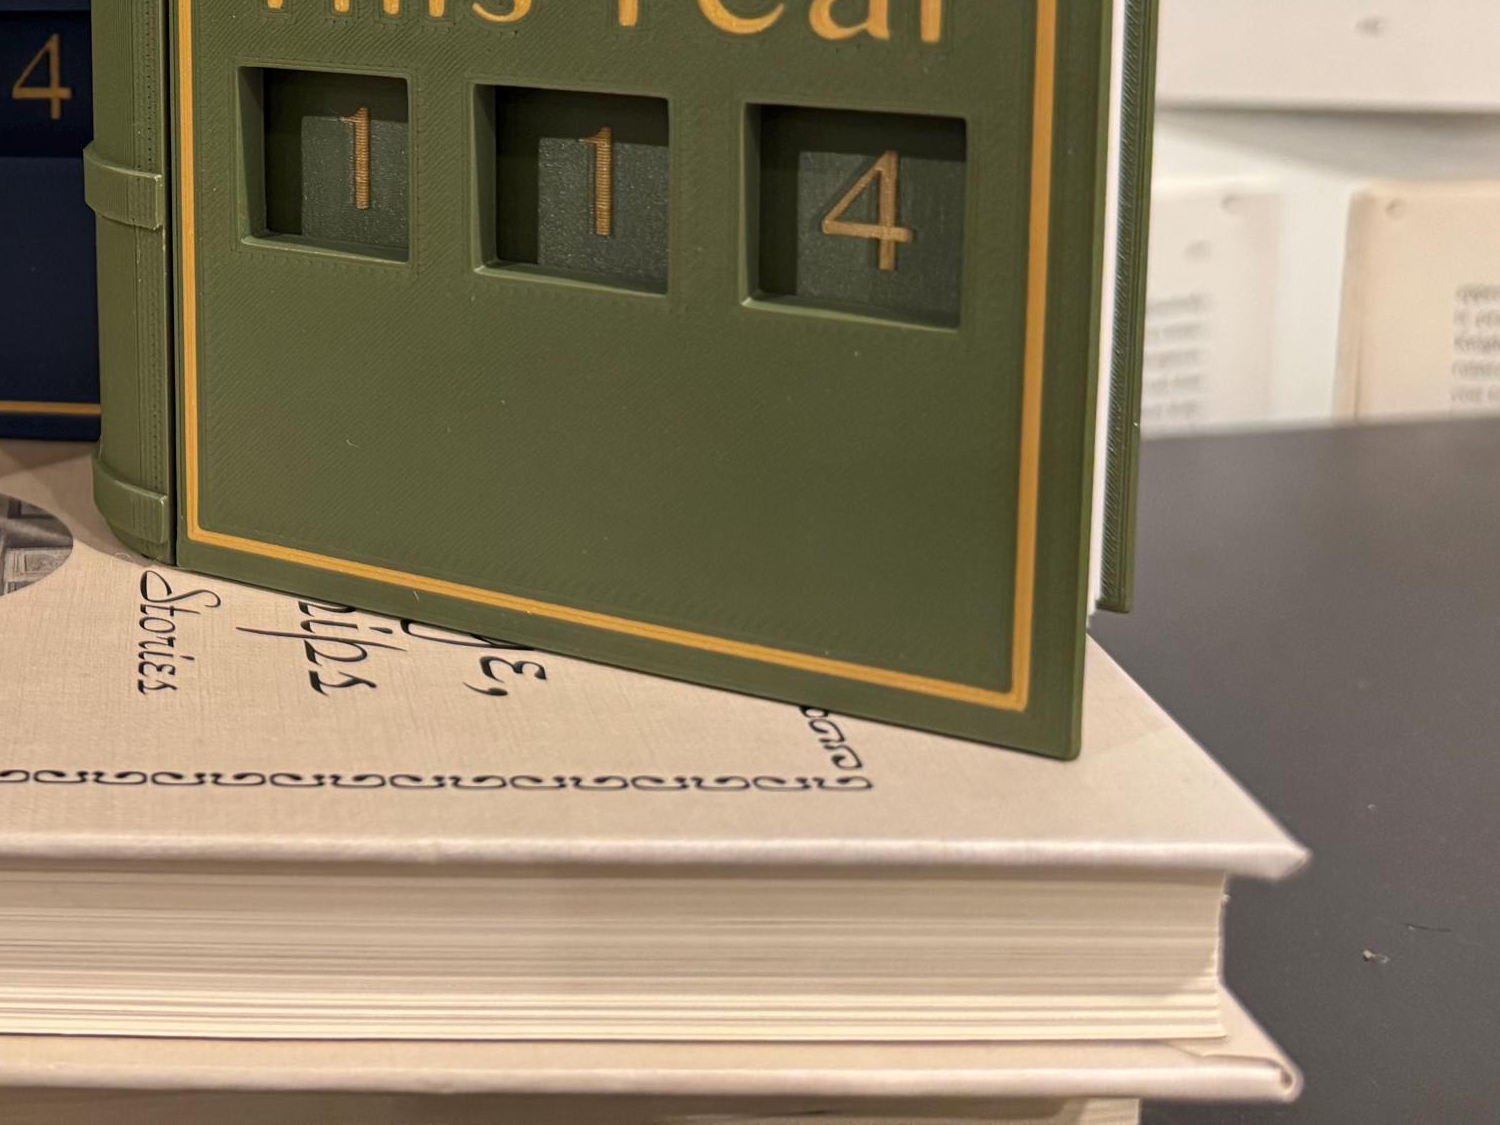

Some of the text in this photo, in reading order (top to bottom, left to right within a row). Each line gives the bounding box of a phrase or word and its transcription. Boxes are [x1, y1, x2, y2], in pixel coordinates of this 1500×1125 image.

[341, 107, 912, 271] 1 1 4
[138, 570, 222, 695] Stories
[235, 601, 408, 696] ips
